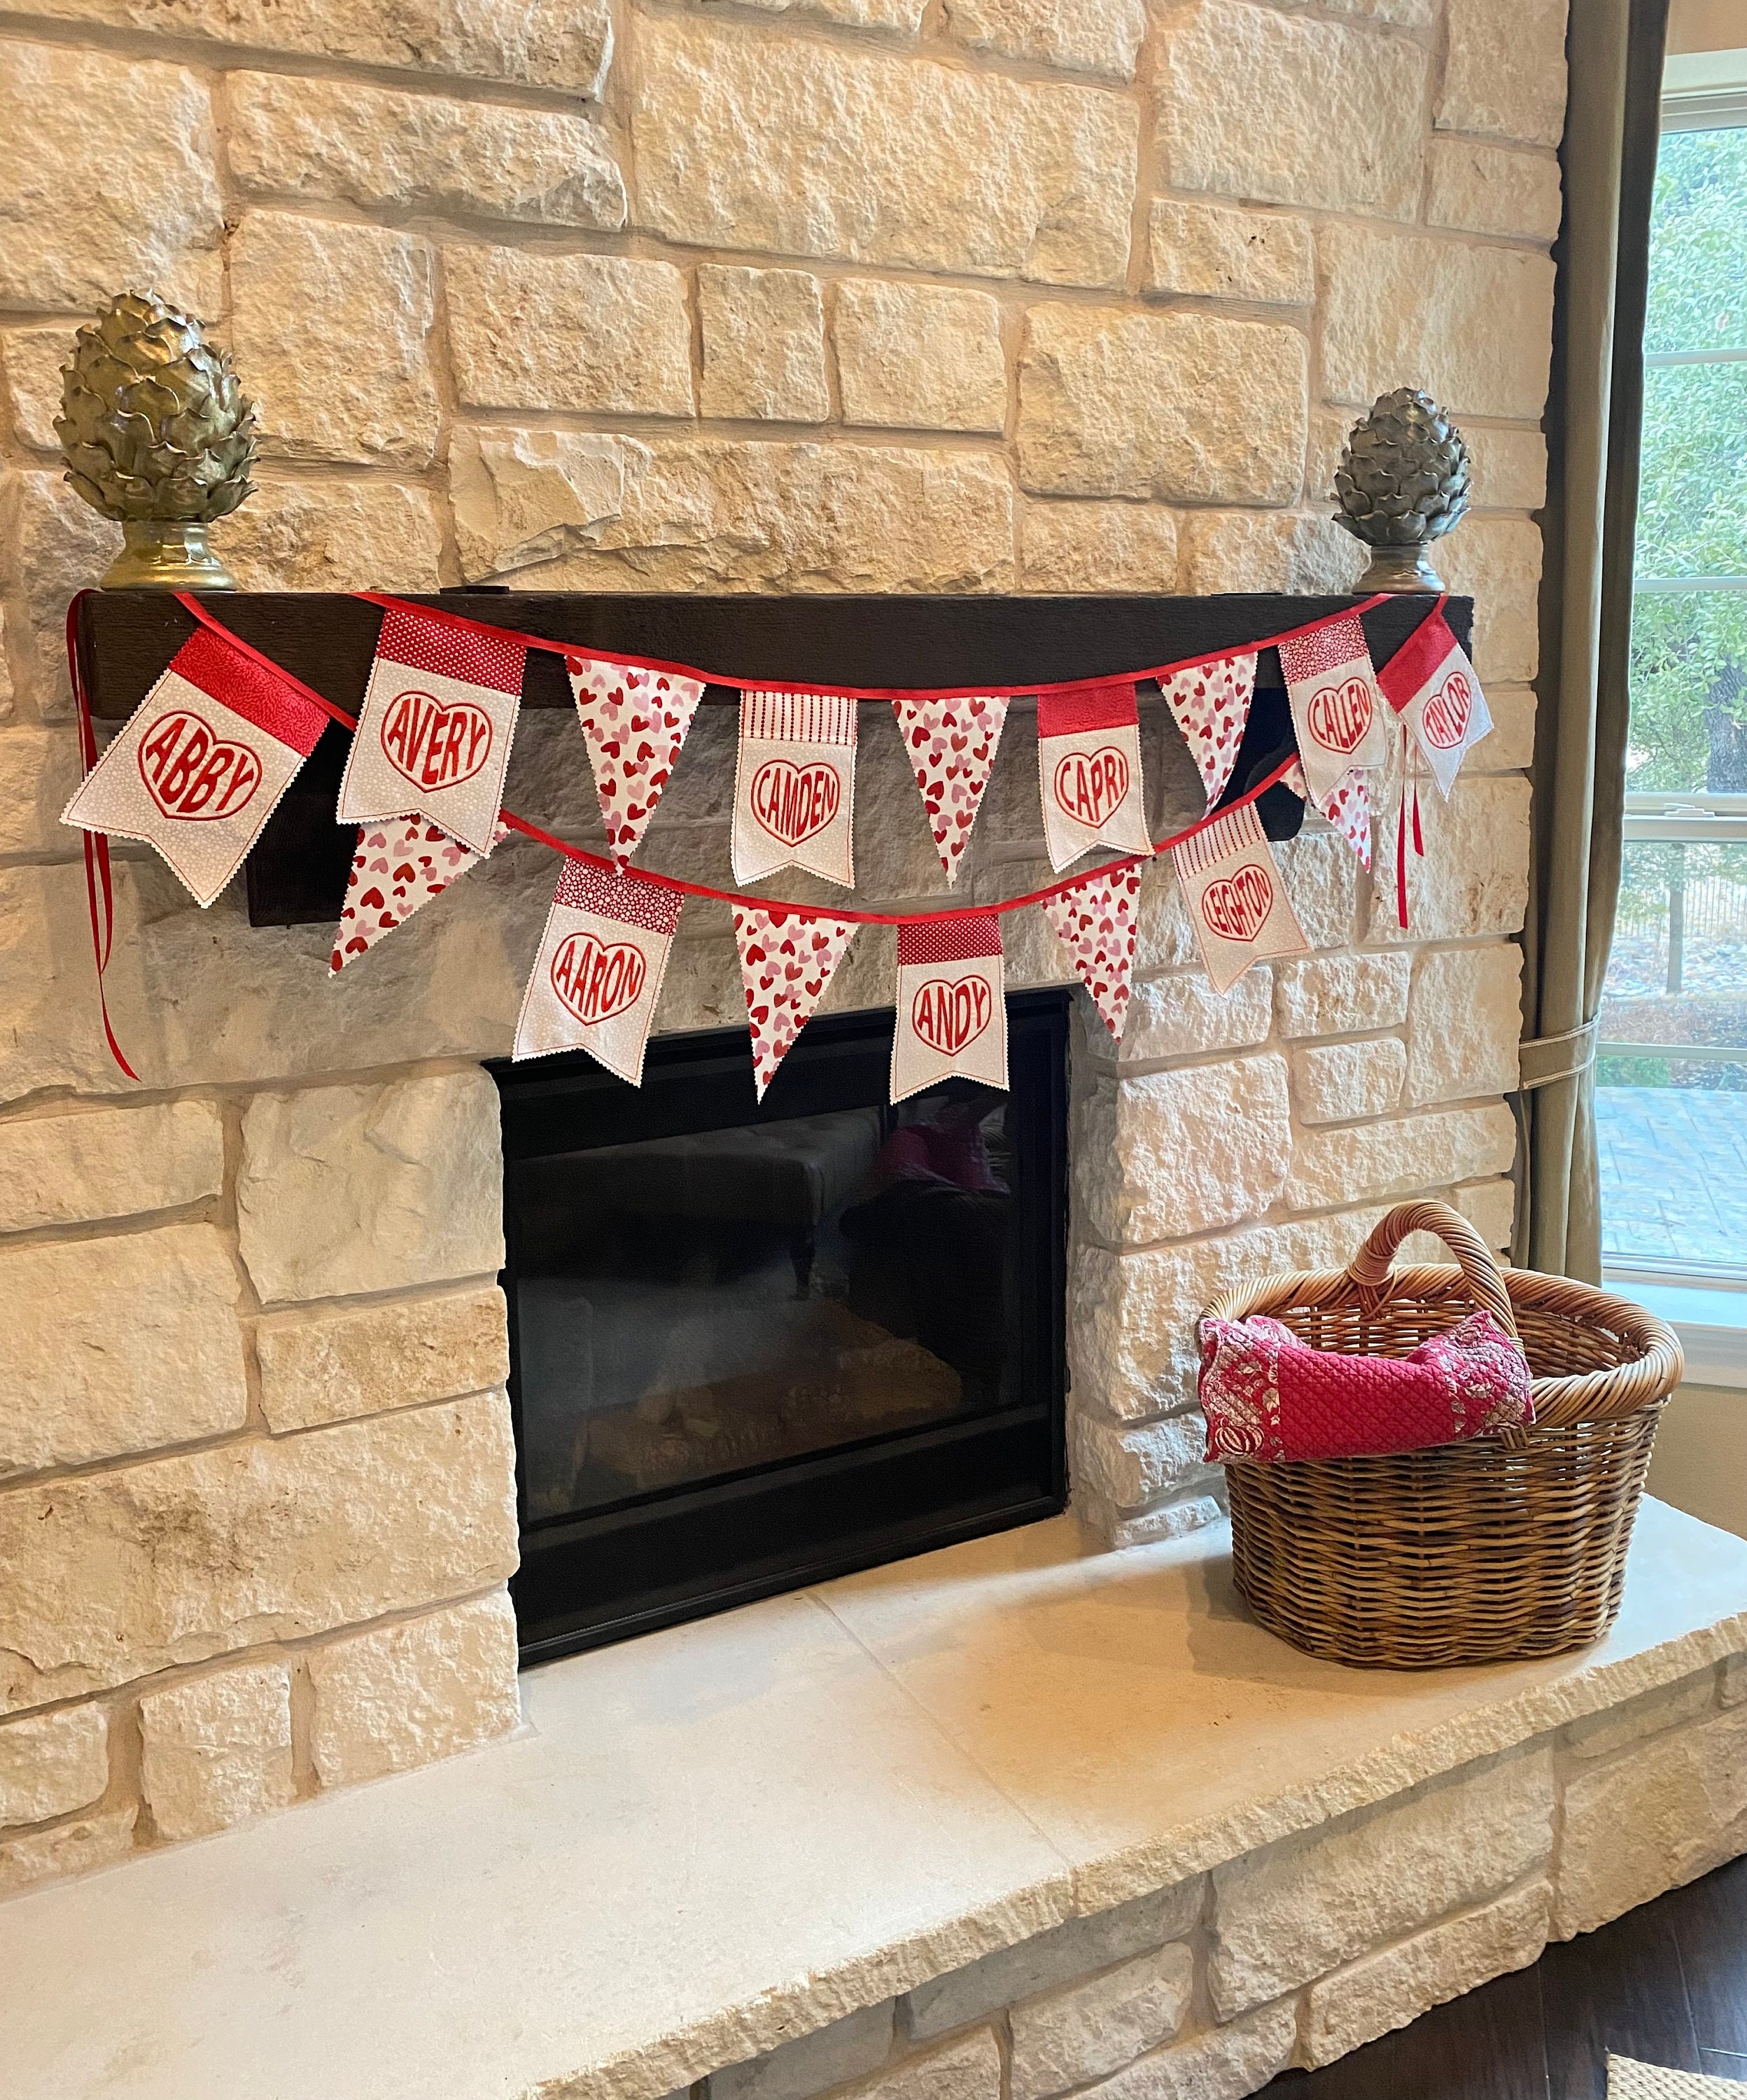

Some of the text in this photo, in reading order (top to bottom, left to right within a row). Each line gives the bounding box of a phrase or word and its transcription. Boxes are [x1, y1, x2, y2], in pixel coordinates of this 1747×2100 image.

[387, 698, 486, 784] AVERY
[1311, 683, 1370, 749] CALLEN
[1426, 676, 1469, 747] TAYLOR
[146, 718, 253, 813] ABBY
[1060, 754, 1125, 822] CAPRI
[757, 767, 836, 839] CAMDEN
[1205, 869, 1270, 937] LEIGHTON
[556, 941, 642, 1018] AARON
[917, 980, 987, 1050] ANDY
